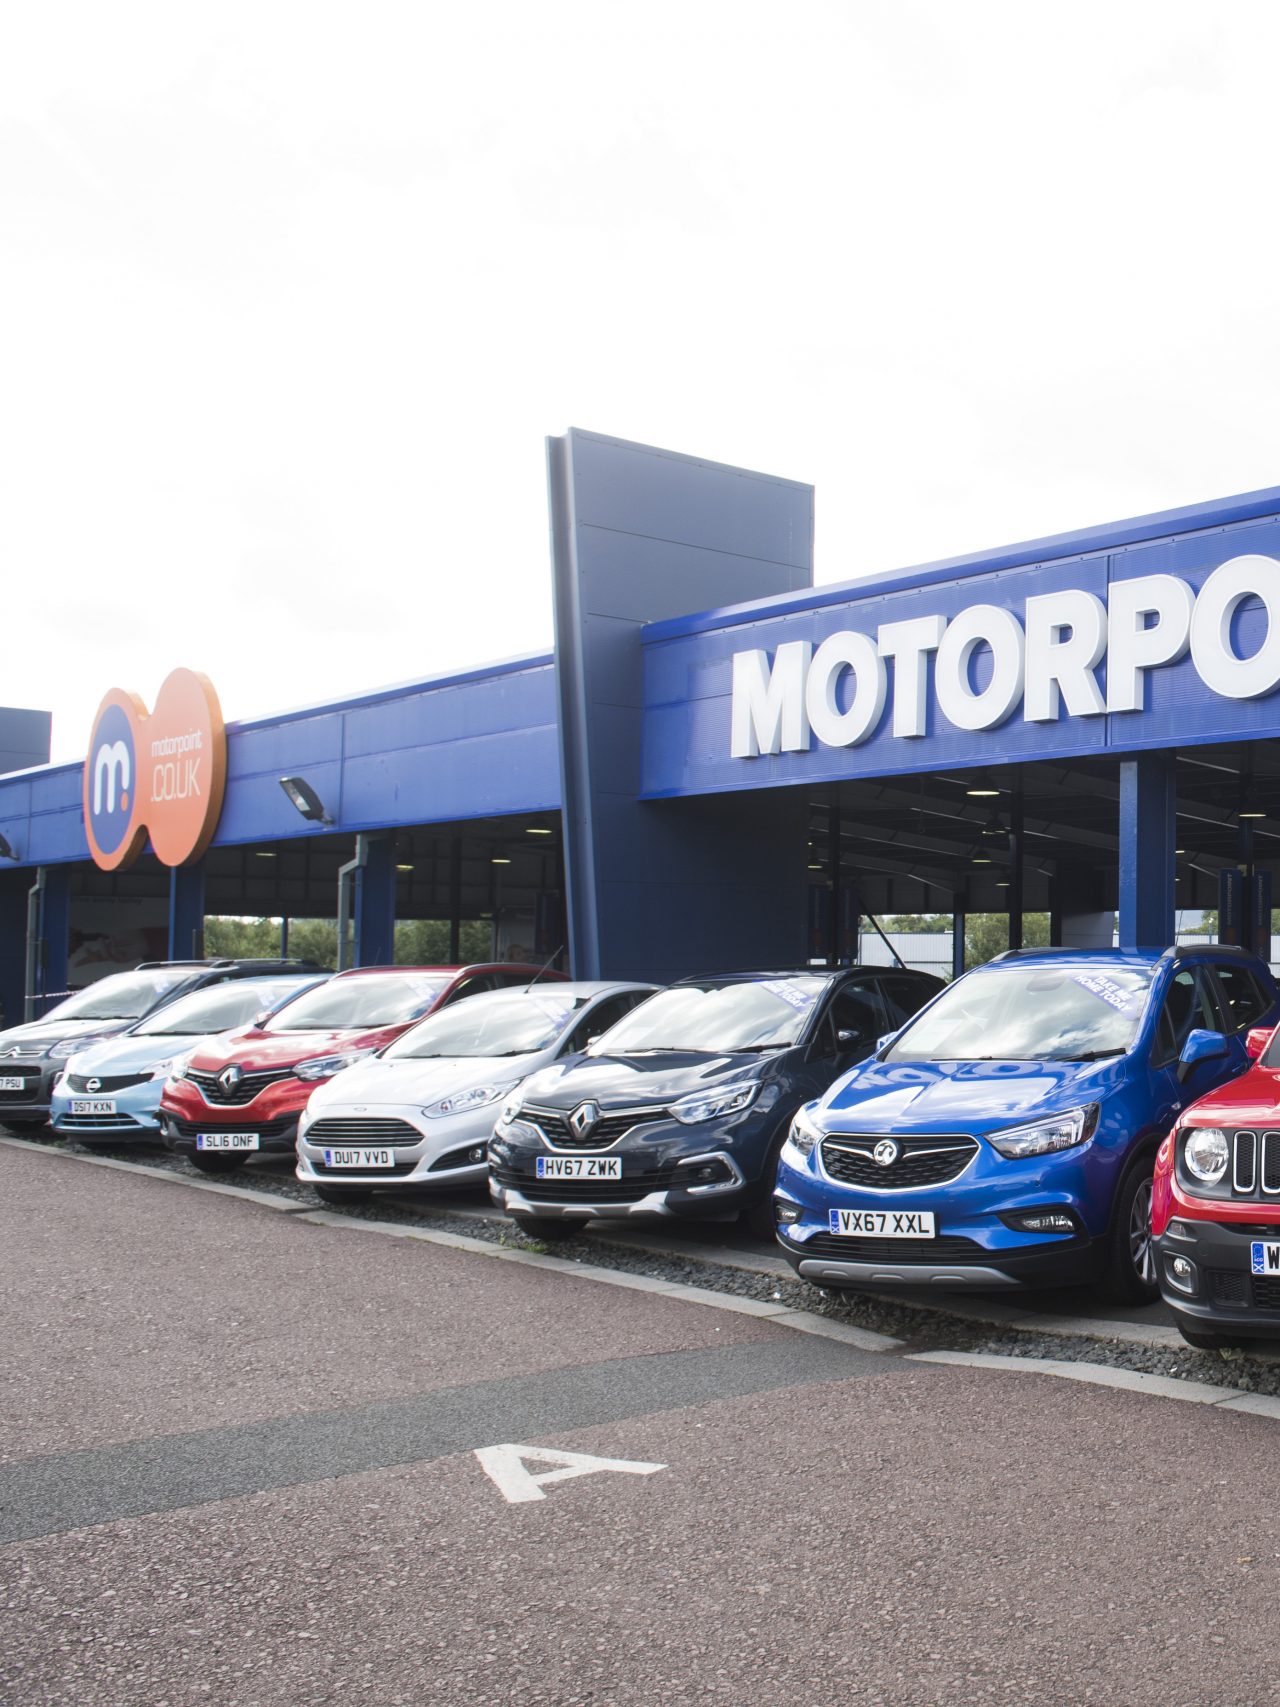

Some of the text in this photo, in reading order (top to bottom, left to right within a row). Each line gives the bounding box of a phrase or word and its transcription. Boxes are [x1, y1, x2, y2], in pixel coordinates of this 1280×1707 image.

[151, 728, 202, 758] motorpoint
[1074, 975, 1133, 1012] HOME TODAY
[1094, 975, 1133, 1001] TAKE ME
[5, 1078, 20, 1088] PSU
[74, 1101, 112, 1112] DS17 KXN
[206, 1135, 254, 1147] SL16 ONF
[335, 1151, 388, 1164] DU17 VVD
[545, 1160, 618, 1176] HV67 ZWK
[841, 1211, 930, 1233] VX67 XXL
[473, 1443, 670, 1504] A
